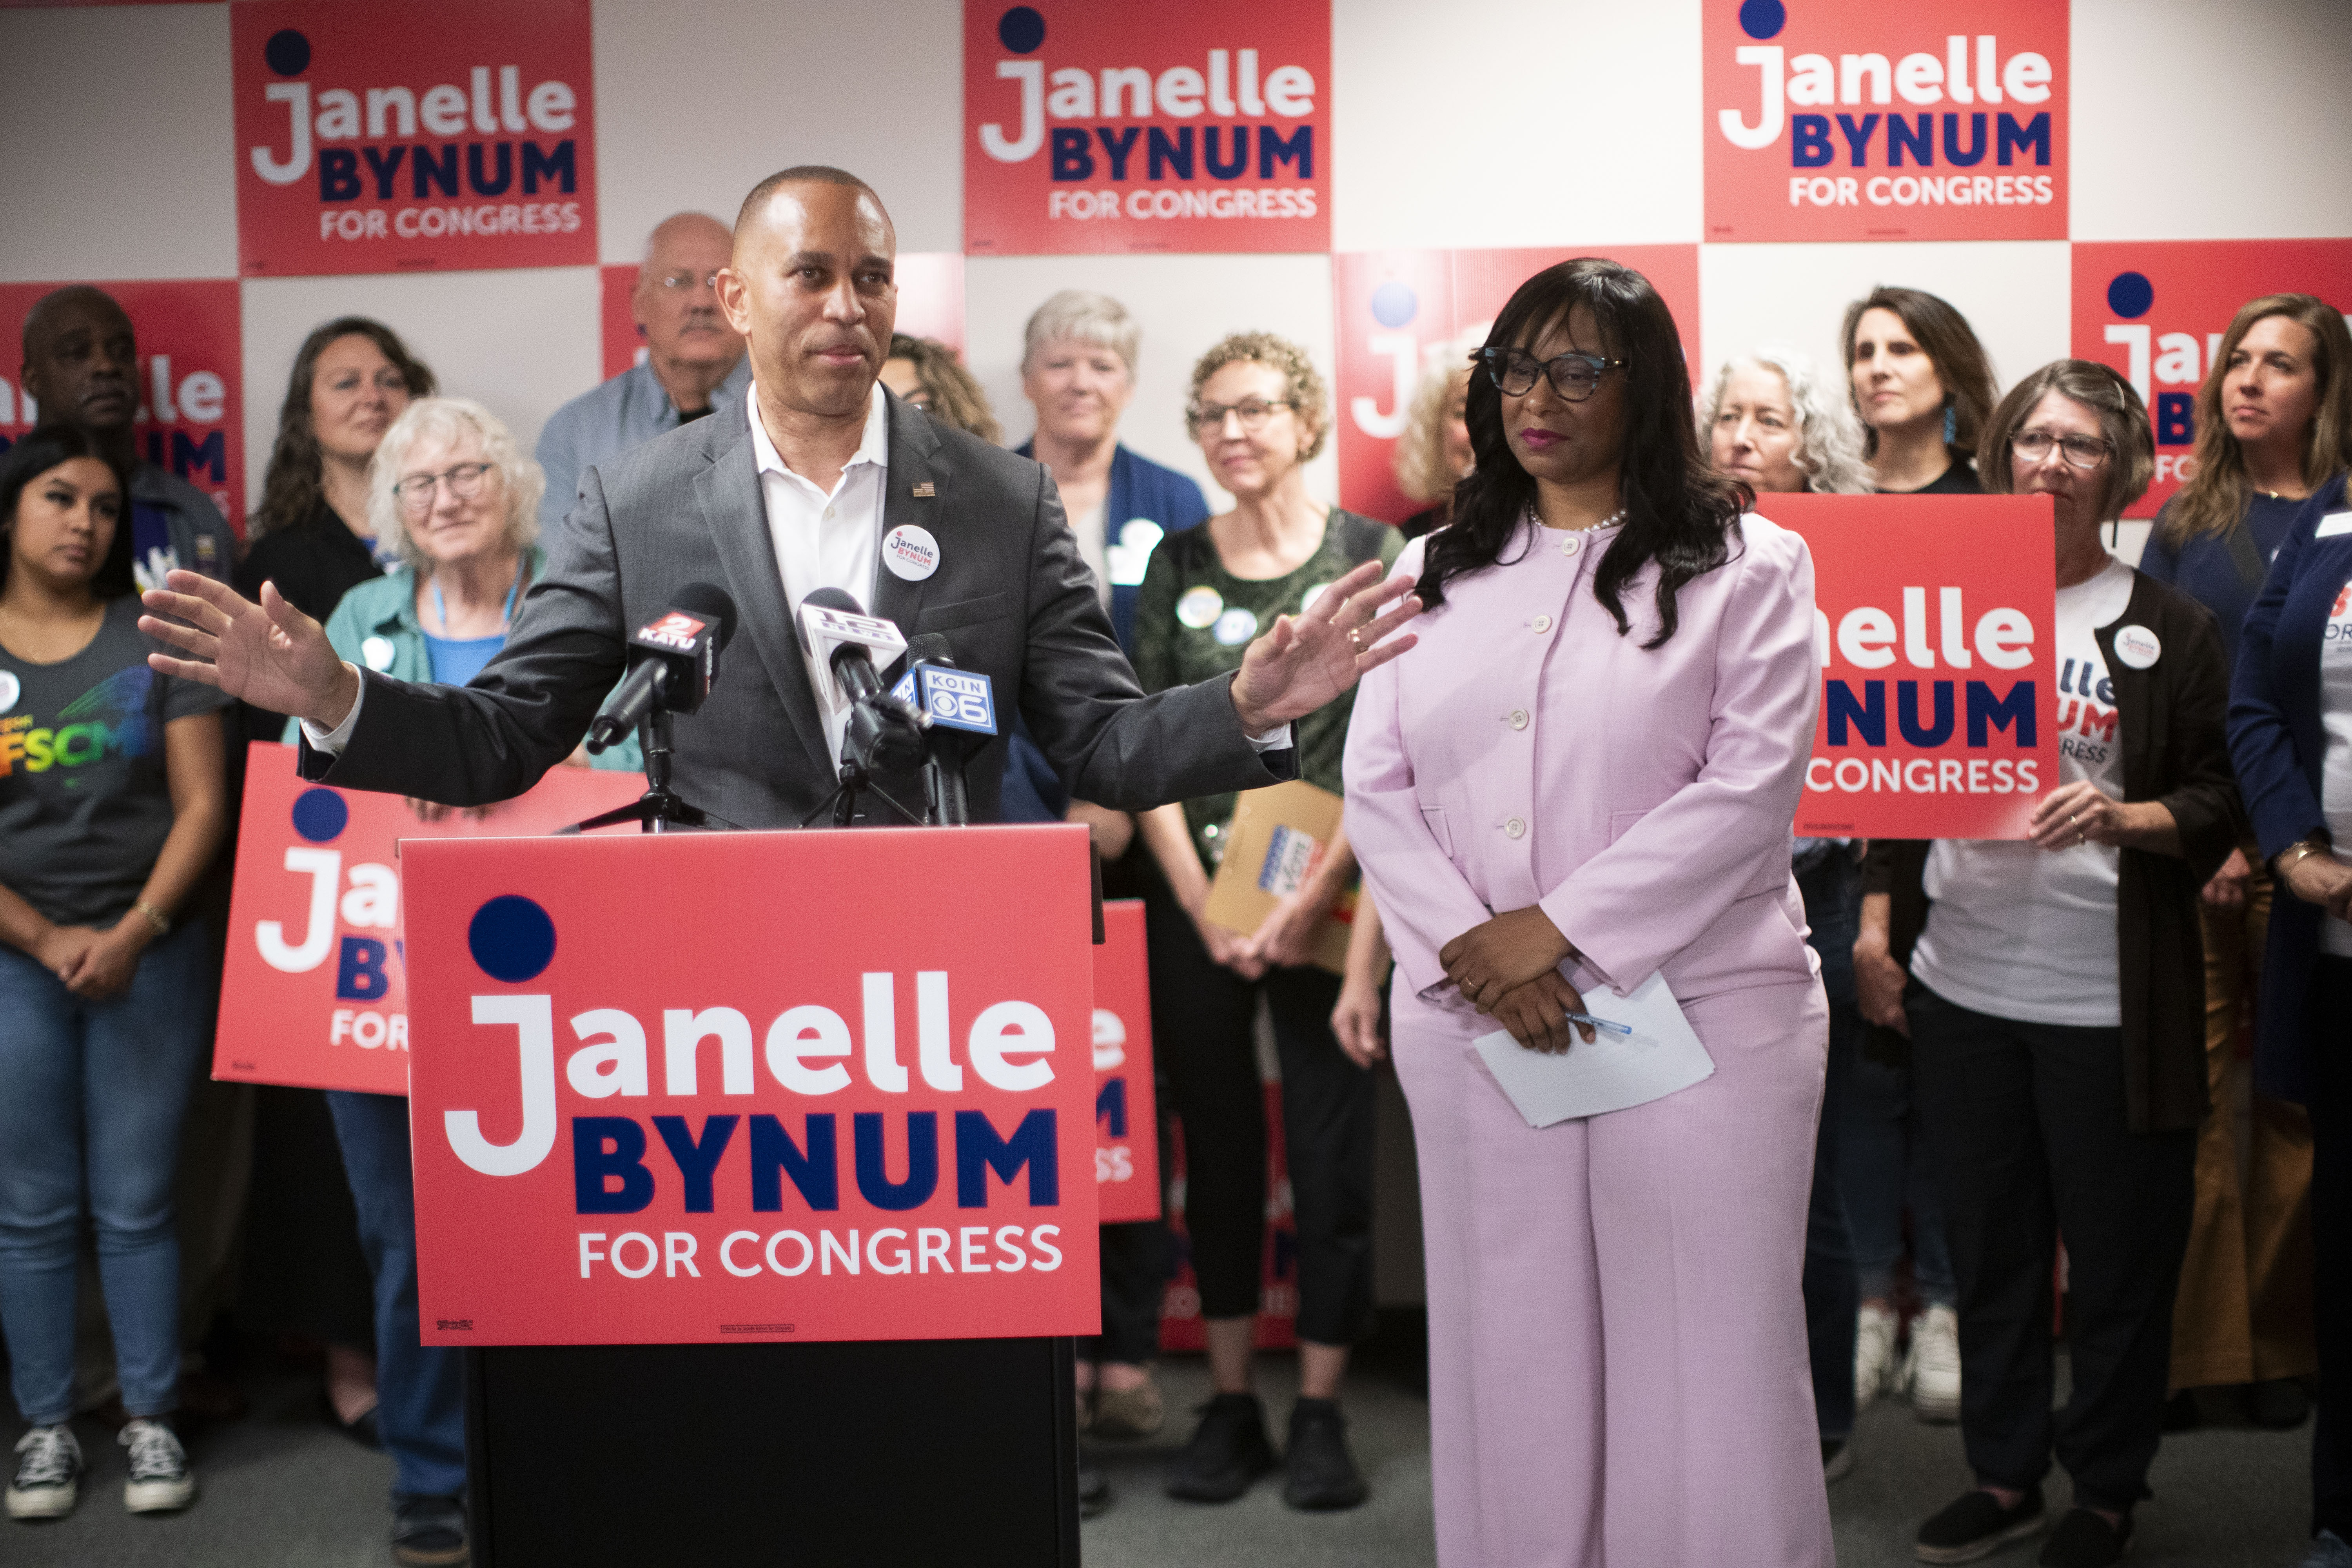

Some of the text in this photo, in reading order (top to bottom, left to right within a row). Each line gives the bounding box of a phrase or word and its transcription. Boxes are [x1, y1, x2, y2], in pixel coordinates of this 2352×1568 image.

[980, 6, 1316, 162] janelle
[1718, 0, 2053, 150] janelle
[252, 30, 575, 184] janelle
[1051, 125, 1312, 181] BYNUM
[1792, 113, 2051, 167] BYNUM
[319, 140, 575, 202] BYNUM
[1049, 187, 1318, 220] FOR CONGRESS
[1790, 176, 2053, 206] FOR CONGRESS
[320, 202, 581, 241] FOR CONGRESS
[2156, 454, 2198, 483] FO
[891, 531, 933, 558] janelle
[898, 547, 931, 565] BYNUM
[906, 558, 929, 570] CONGRESS
[638, 628, 696, 650] KATU
[658, 617, 691, 636] 2
[2325, 623, 2352, 640] OR
[933, 675, 981, 693] KOIN
[959, 695, 987, 723] 6
[1827, 680, 2037, 748] NUM
[2062, 738, 2108, 764] RESS
[1806, 757, 2039, 793] CONGRESS
[330, 1009, 408, 1051] FOR
[444, 895, 1056, 1176] janelle
[572, 1109, 1060, 1215] BYNUM
[578, 1224, 1063, 1279] FOR CONGRESS
